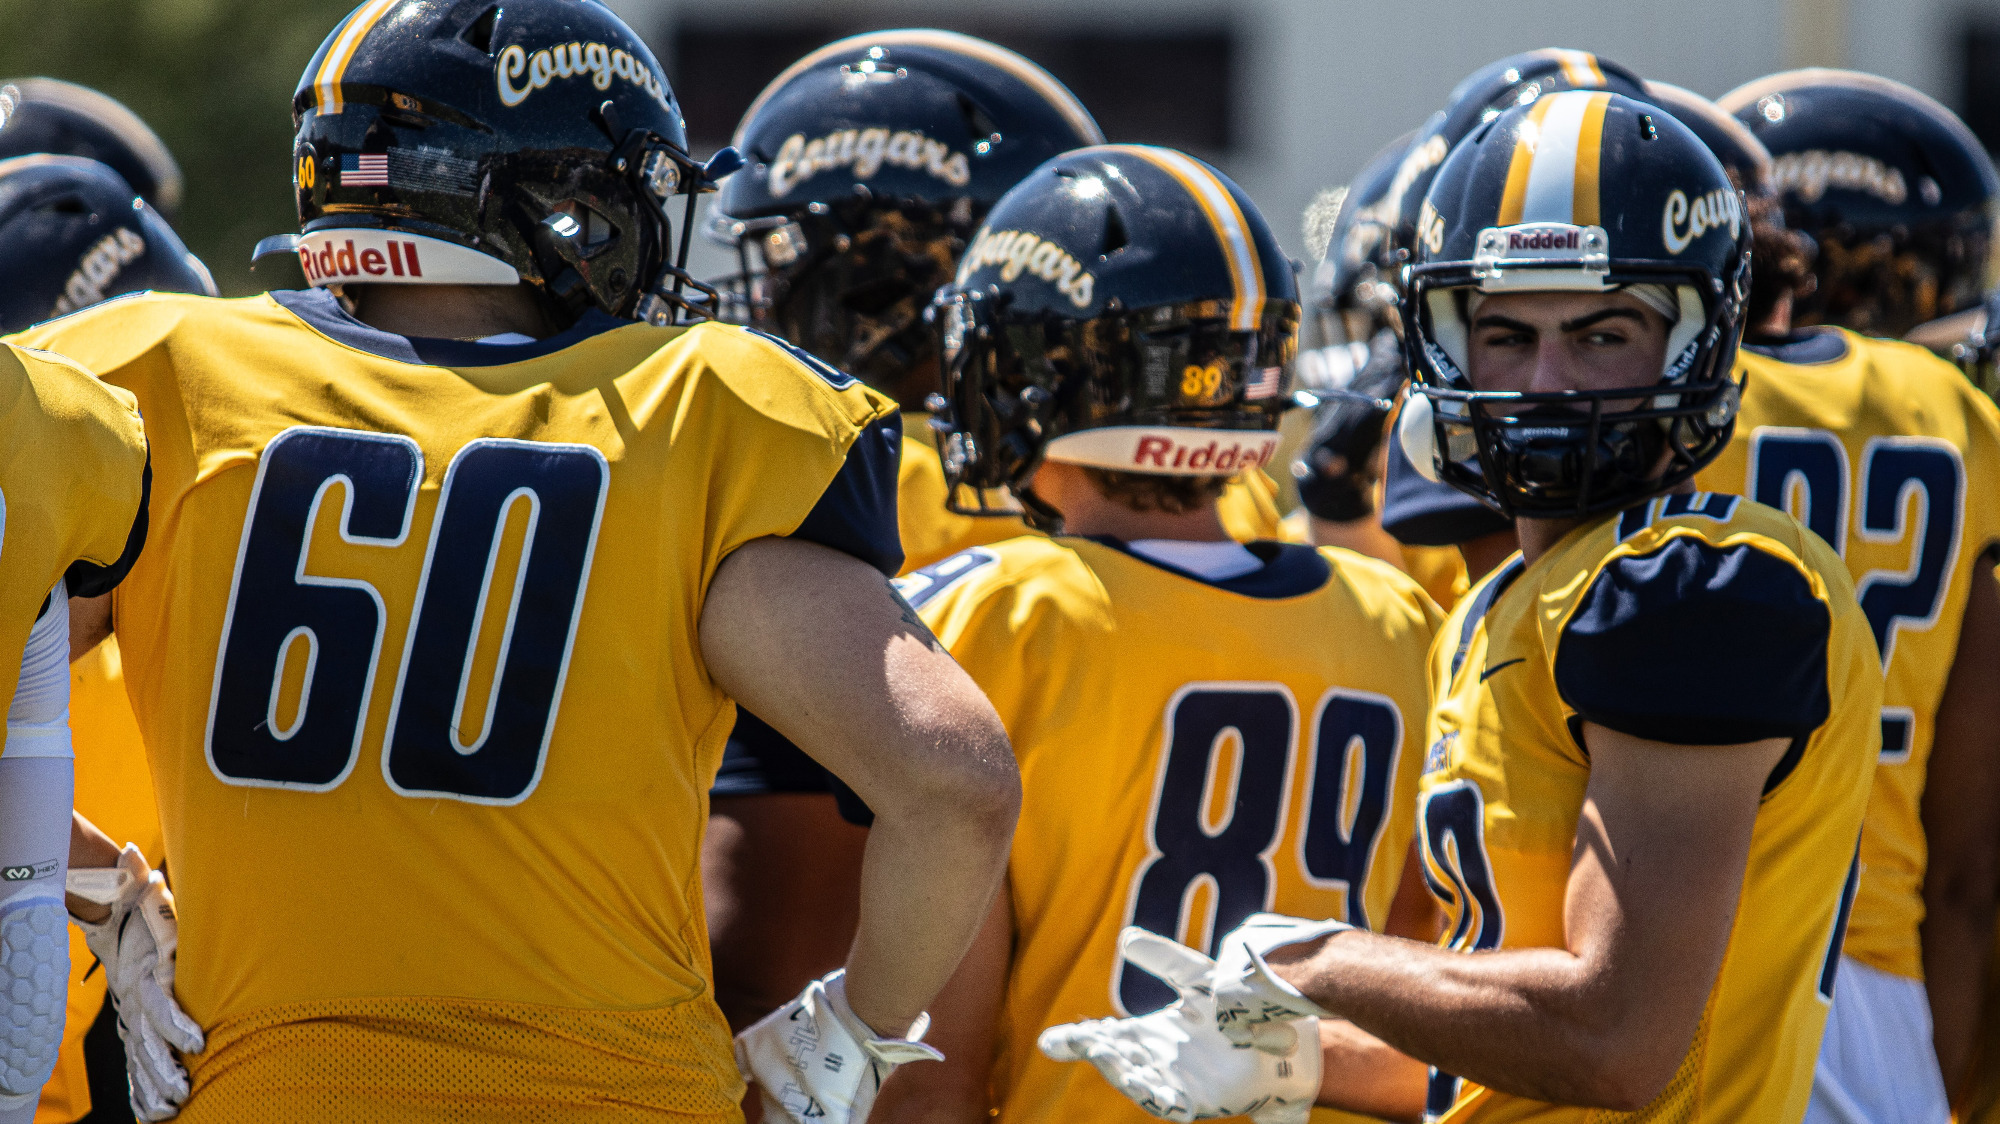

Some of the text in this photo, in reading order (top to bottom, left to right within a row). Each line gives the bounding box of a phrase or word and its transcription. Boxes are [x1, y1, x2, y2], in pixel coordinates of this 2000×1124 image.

[298, 155, 315, 189] 60
[769, 128, 970, 197] Cougars
[1509, 230, 1579, 249] Riddell
[1663, 189, 1740, 255] Coug
[300, 239, 423, 281] Riddell
[1181, 364, 1223, 397] 89
[1134, 434, 1277, 470] Riddell
[205, 425, 610, 806] 60
[1110, 680, 1403, 1016] 89
